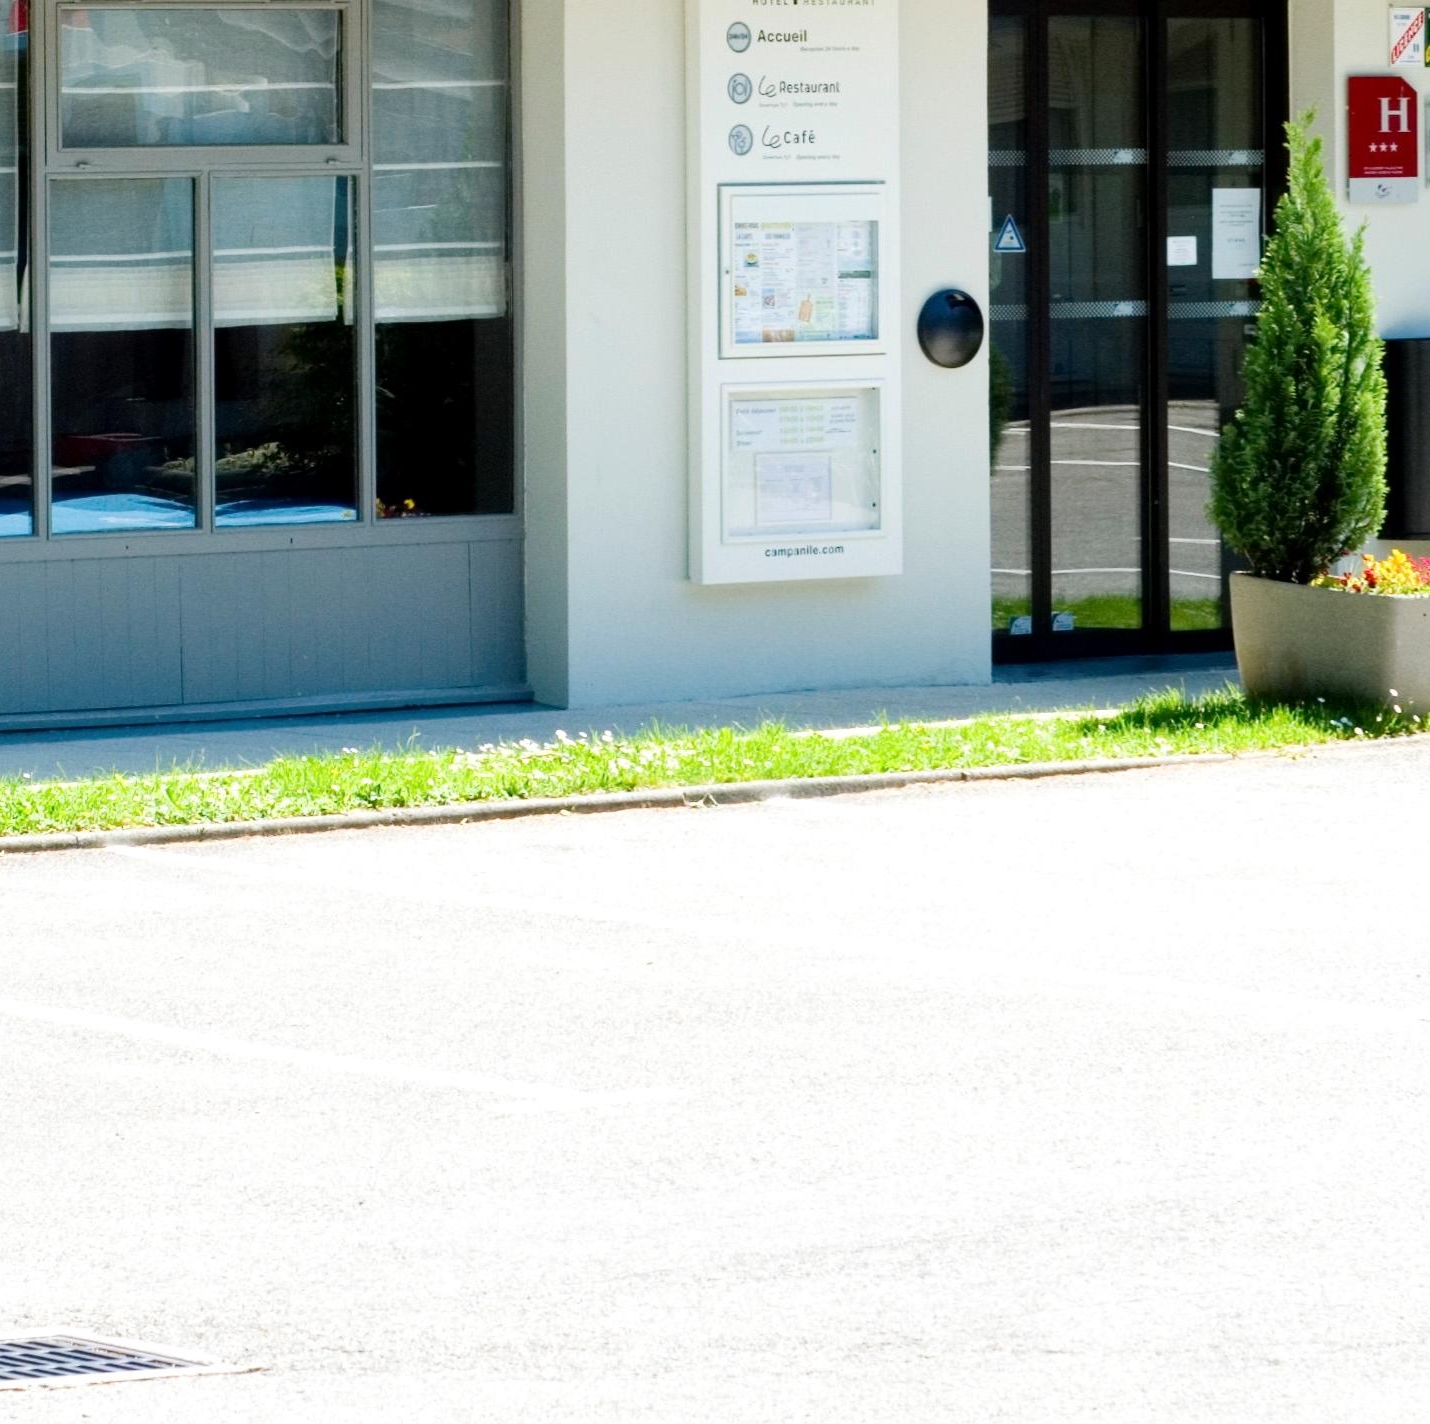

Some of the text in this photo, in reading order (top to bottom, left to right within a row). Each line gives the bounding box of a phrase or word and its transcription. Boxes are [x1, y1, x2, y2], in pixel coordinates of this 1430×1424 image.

[757, 29, 808, 43] Accueil
[758, 75, 840, 98] Le Restaurant
[1378, 97, 1411, 133] H
[761, 125, 816, 149] Le Café
[764, 544, 844, 558] campanile.com
